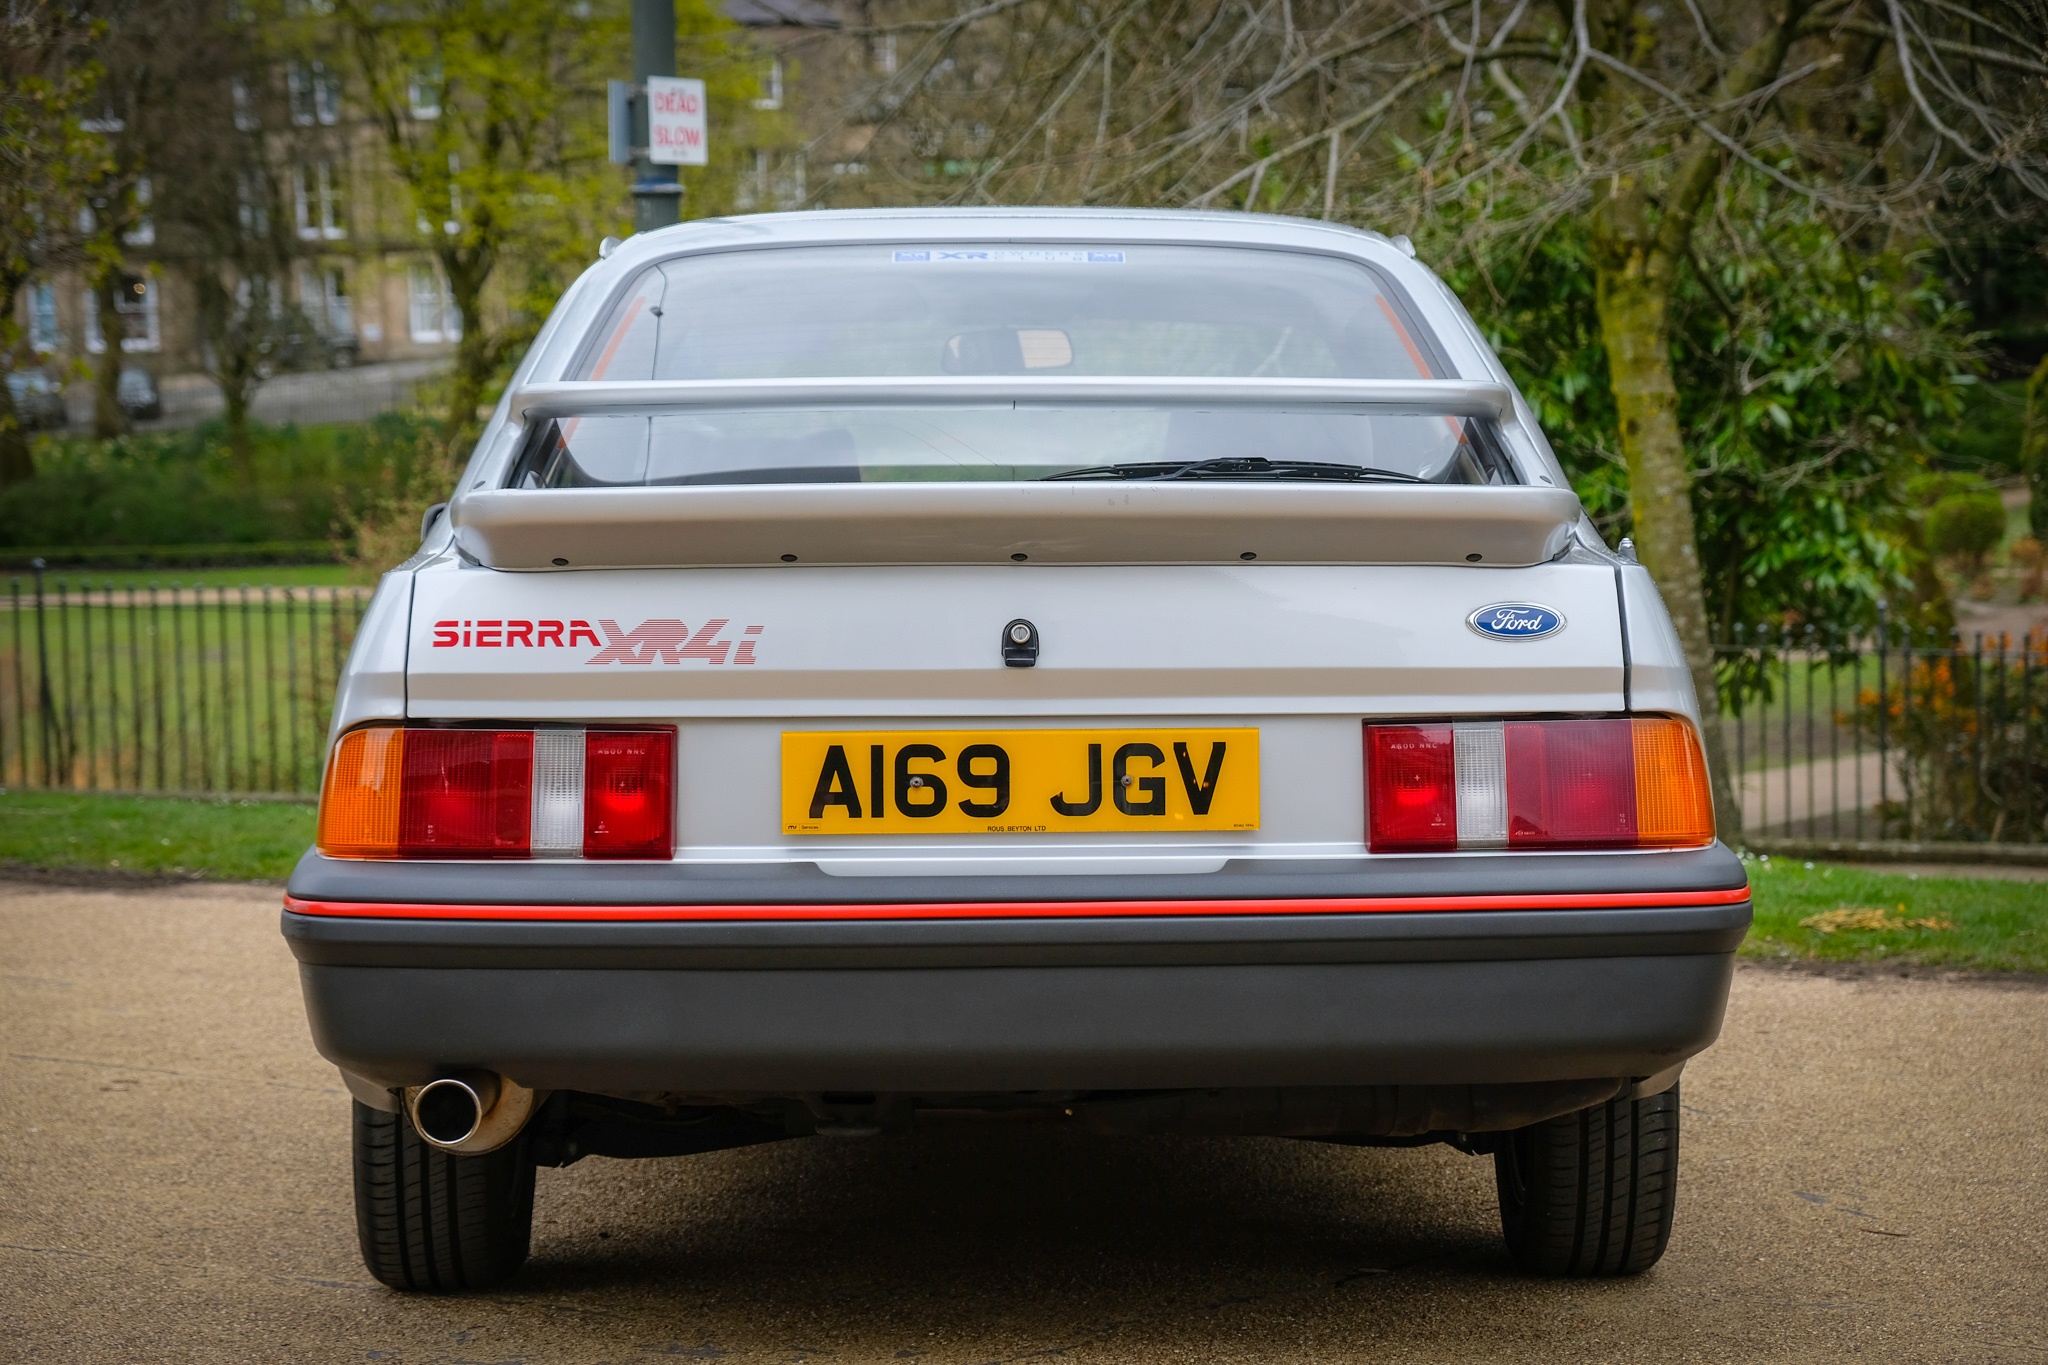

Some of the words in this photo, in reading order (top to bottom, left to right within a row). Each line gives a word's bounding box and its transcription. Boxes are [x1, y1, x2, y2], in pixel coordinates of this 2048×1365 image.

[653, 91, 699, 115] DEAD
[653, 124, 701, 146] SLOW
[936, 250, 988, 260] XR
[1491, 608, 1543, 631] Ford
[584, 618, 765, 665] XR4i
[808, 743, 1011, 819] A169
[1050, 741, 1227, 816] JGV
